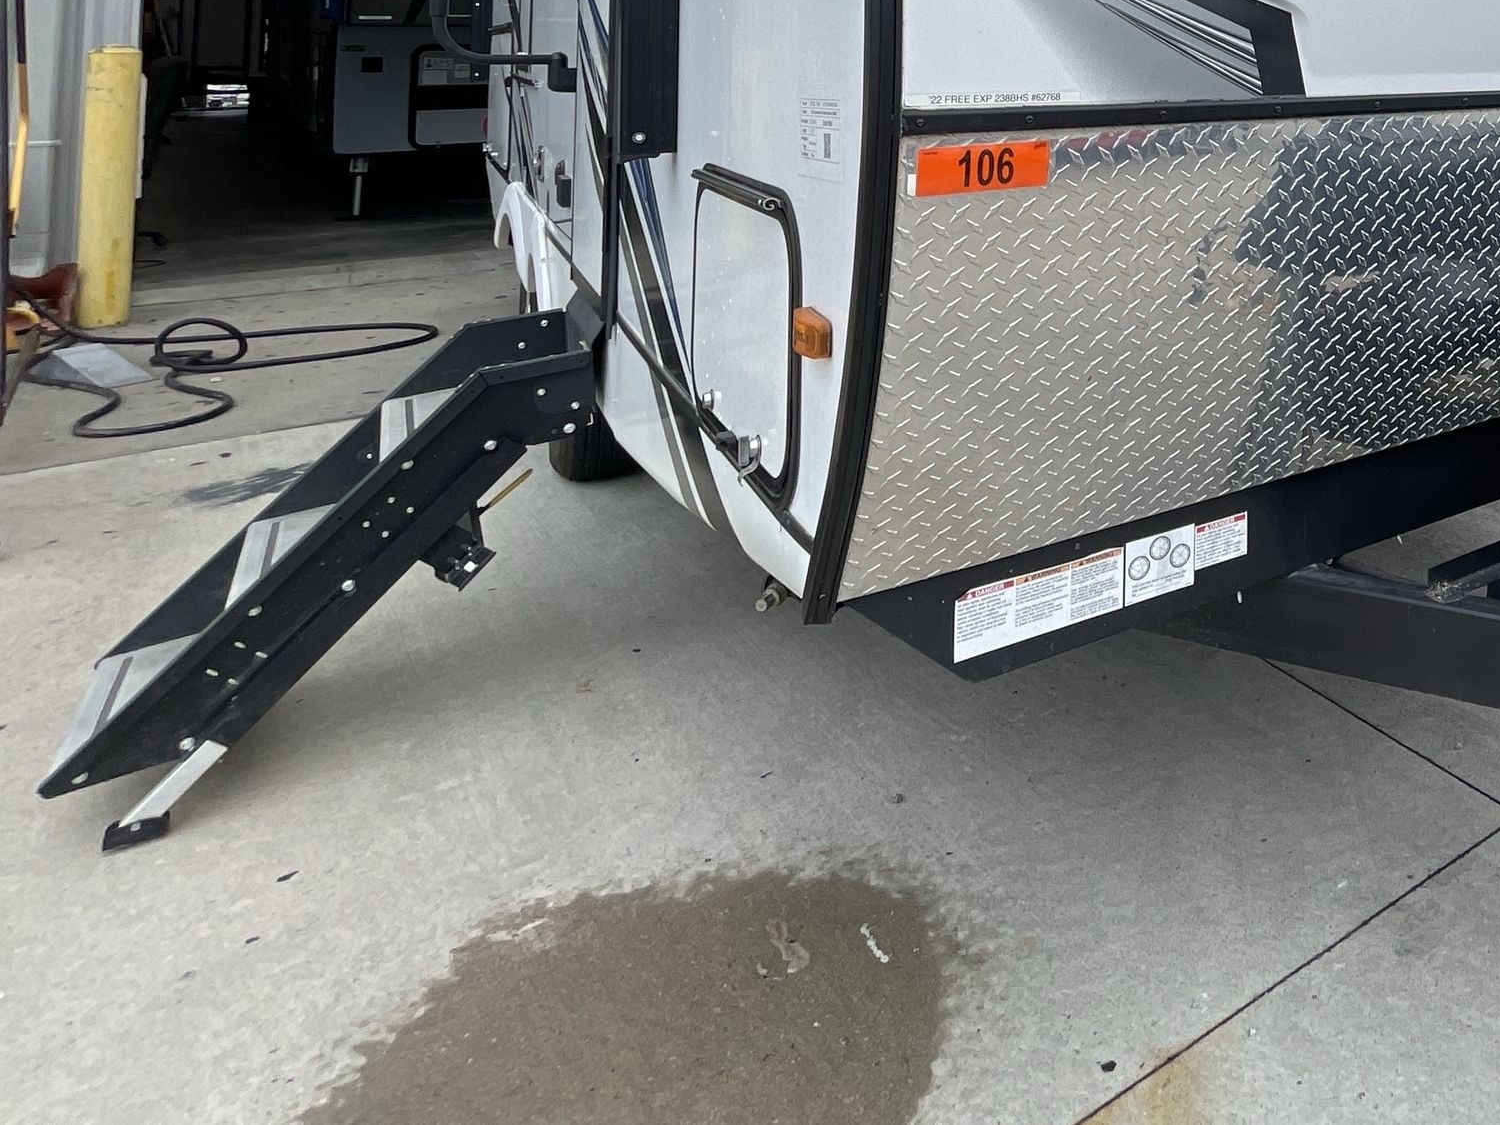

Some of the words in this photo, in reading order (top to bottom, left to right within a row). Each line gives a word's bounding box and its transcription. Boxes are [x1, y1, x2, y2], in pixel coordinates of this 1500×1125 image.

[945, 94, 970, 104] FREE
[973, 94, 992, 103] EXP
[958, 148, 1014, 187] 106
[975, 582, 1005, 597] DANGER
